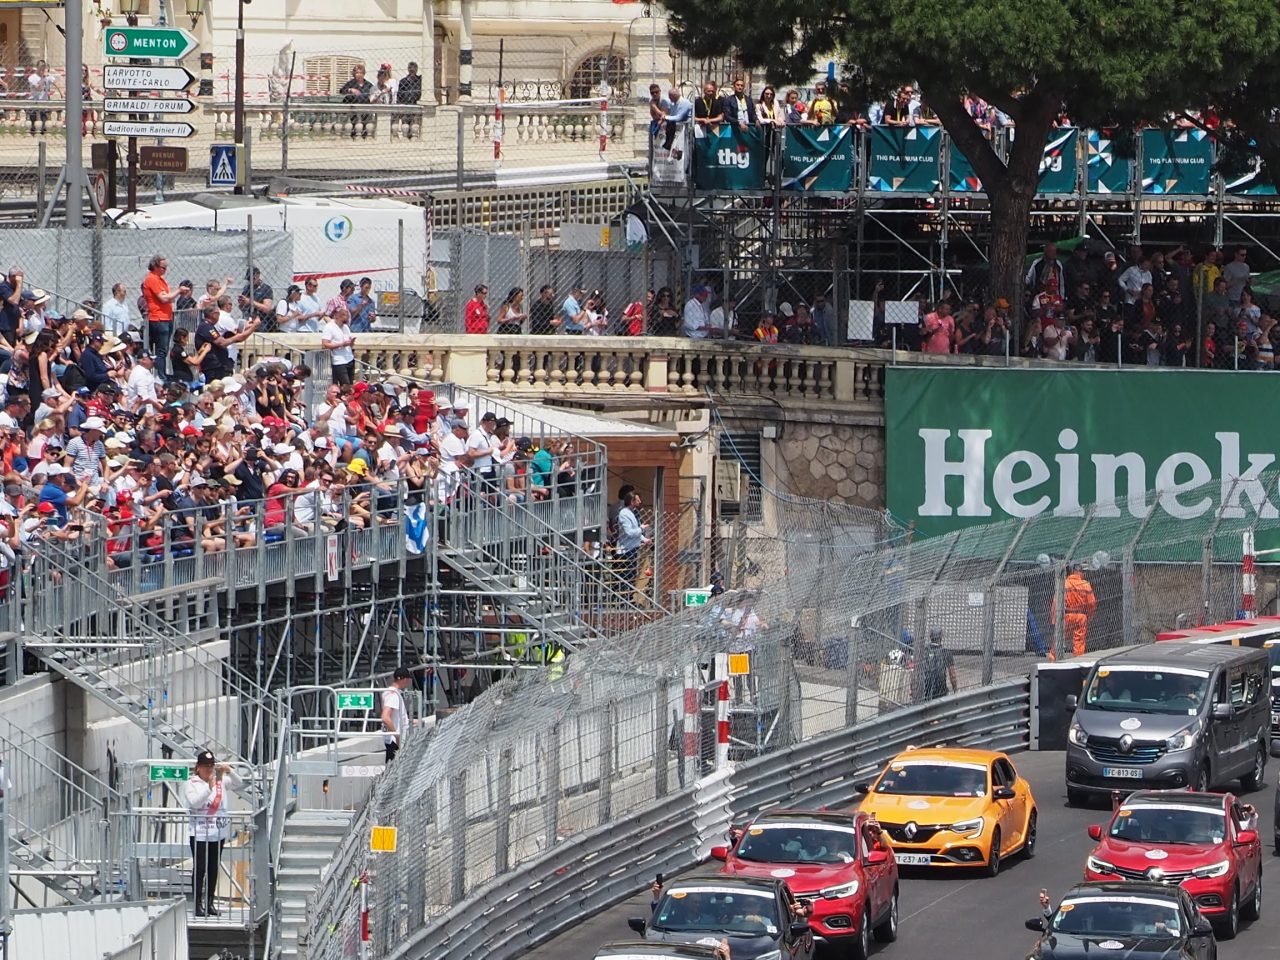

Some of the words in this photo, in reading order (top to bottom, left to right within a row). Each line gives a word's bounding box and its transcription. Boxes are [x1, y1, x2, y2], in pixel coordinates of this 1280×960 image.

[134, 38, 177, 48] MENTON
[107, 69, 152, 77] LARVOTTO
[107, 78, 170, 87] MONTE-CARLO
[106, 101, 150, 109] GRIMALDI
[154, 102, 184, 110] FORUM
[107, 124, 147, 133] Auditorium
[149, 126, 175, 134] Rainier
[717, 149, 750, 168] thg
